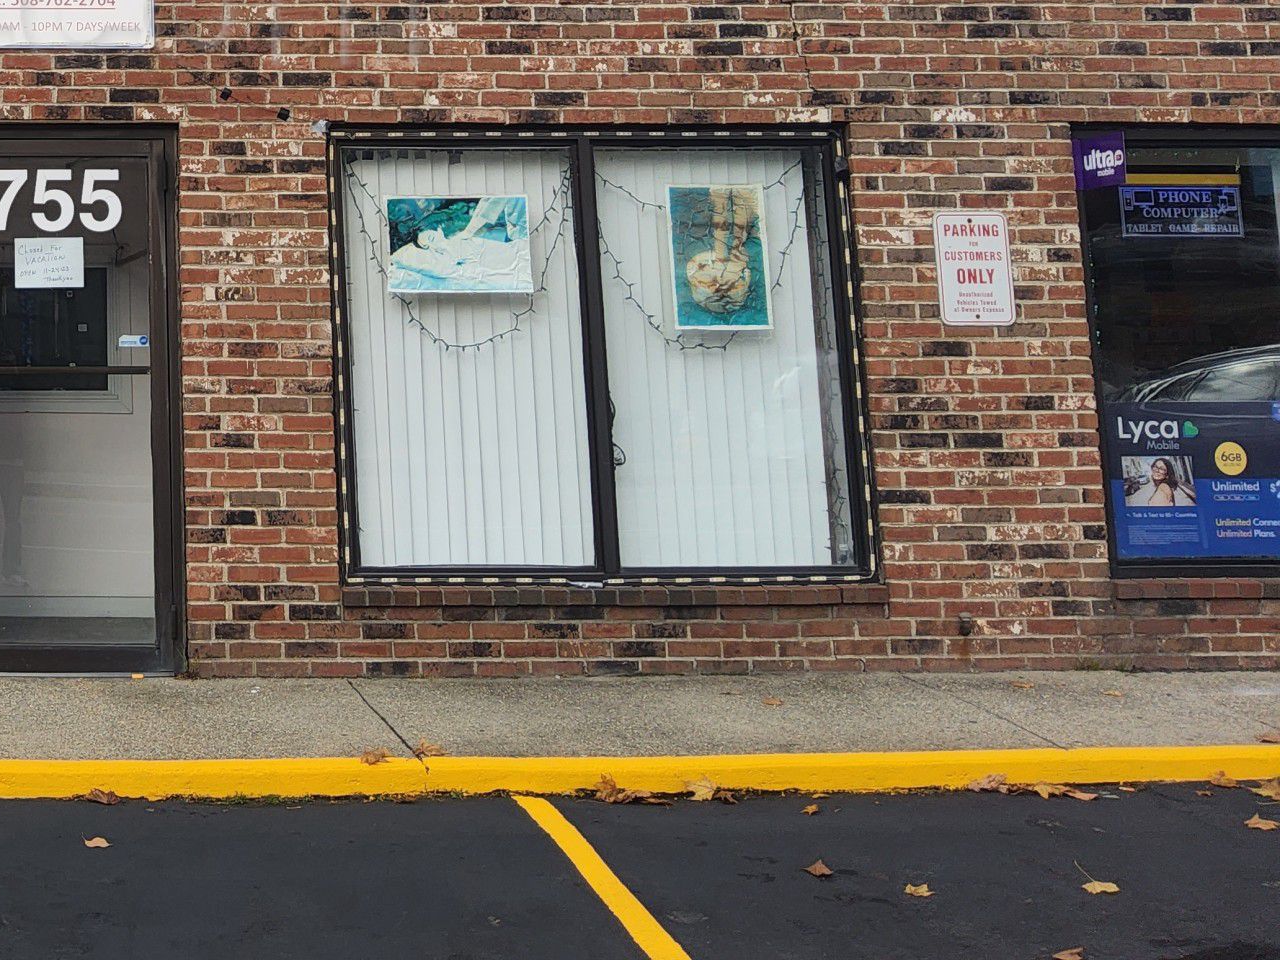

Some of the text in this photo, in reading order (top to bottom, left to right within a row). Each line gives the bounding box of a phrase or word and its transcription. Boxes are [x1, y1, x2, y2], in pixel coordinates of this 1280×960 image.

[31, 21, 63, 32] 10PM
[66, 21, 72, 32] 7
[76, 21, 141, 33] DAYS/WEEK
[1097, 167, 1115, 177] mobile
[1158, 190, 1212, 203] PHONE
[1143, 207, 1220, 219] COMPUTER
[943, 224, 999, 237] PARKING
[1126, 223, 1240, 233] TABLET GAME REPAIR
[944, 251, 1002, 262] CUSTOMERS
[956, 268, 995, 285] ONLY
[1117, 417, 1180, 443] Lyca
[1146, 441, 1180, 450] Mobile
[1220, 451, 1242, 462] 6GB
[1212, 481, 1260, 492] Unlimited
[1215, 518, 1251, 527] Unlimited
[1216, 529, 1253, 538] Unlimited
